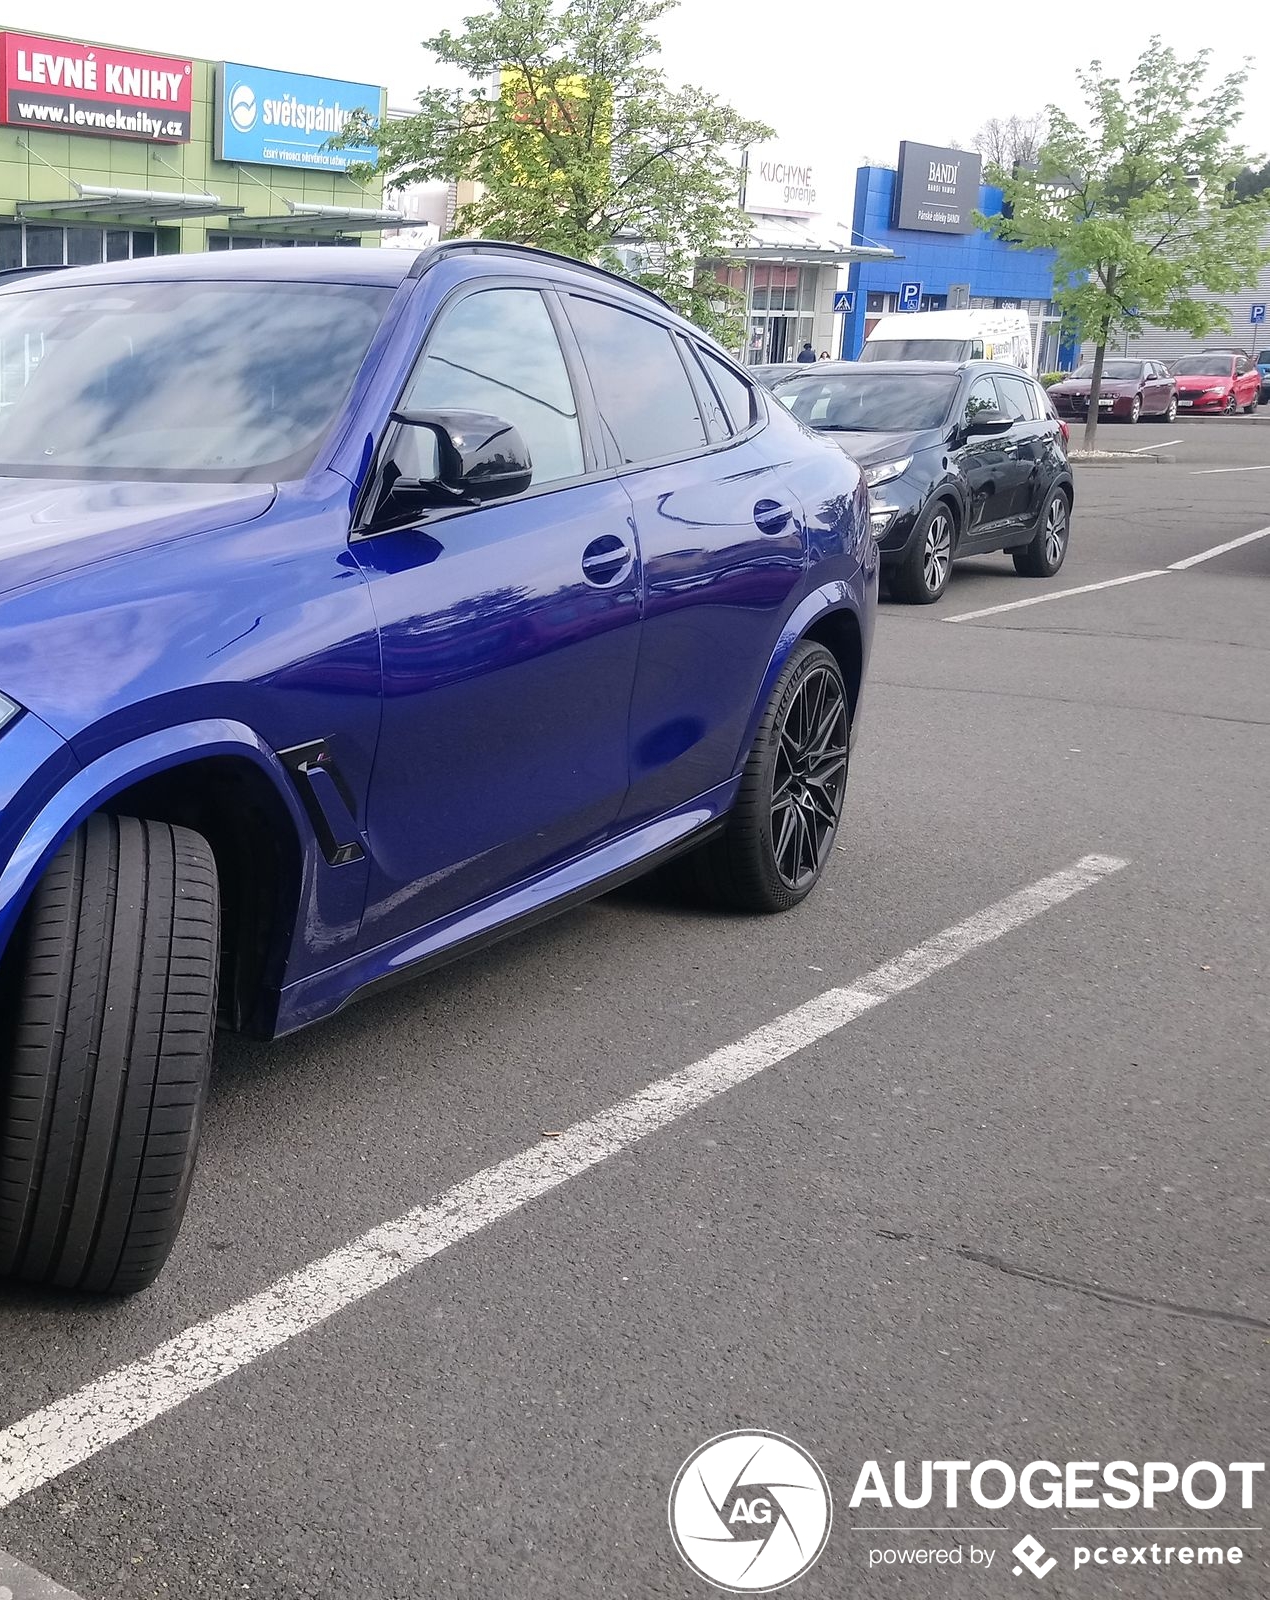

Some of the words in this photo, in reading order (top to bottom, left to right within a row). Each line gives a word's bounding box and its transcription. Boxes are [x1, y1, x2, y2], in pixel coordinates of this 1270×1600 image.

[17, 50, 97, 91] LEVNÉ
[105, 63, 183, 101] KNIHY
[17, 102, 183, 138] www.levneknihy.cz
[760, 161, 813, 187] KUCHYNĚ
[928, 161, 959, 185] BANDI
[783, 184, 817, 206] gorenje
[904, 285, 918, 303] P
[1253, 306, 1264, 319] P
